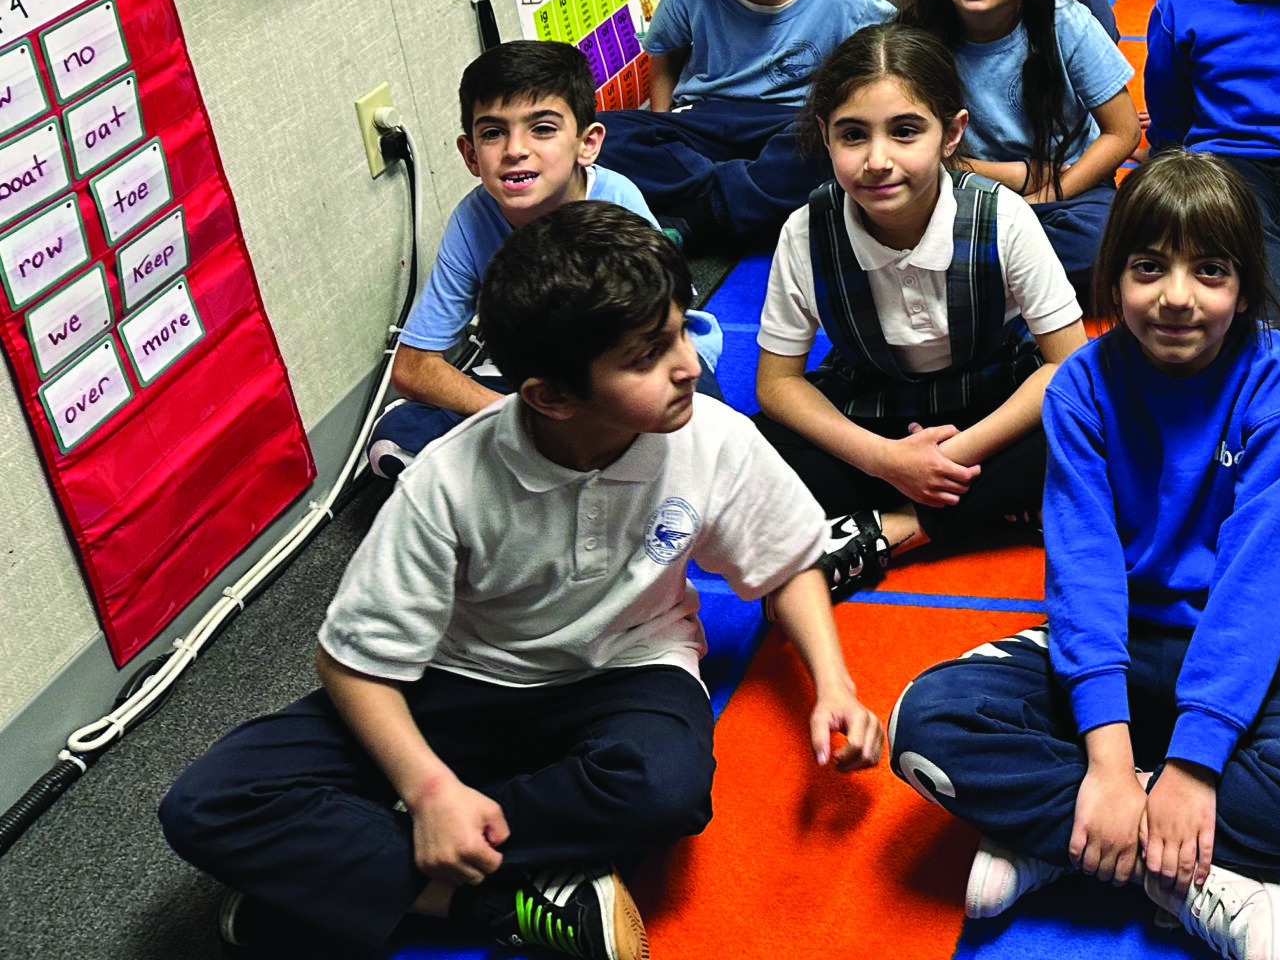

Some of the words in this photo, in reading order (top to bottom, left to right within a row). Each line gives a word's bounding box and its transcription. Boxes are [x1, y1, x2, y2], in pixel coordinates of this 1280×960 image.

[63, 46, 95, 72] no
[85, 105, 126, 148] oat
[113, 182, 149, 213] toe
[19, 237, 63, 278] row
[48, 314, 82, 345] we
[142, 313, 190, 356] more
[65, 377, 109, 423] over
